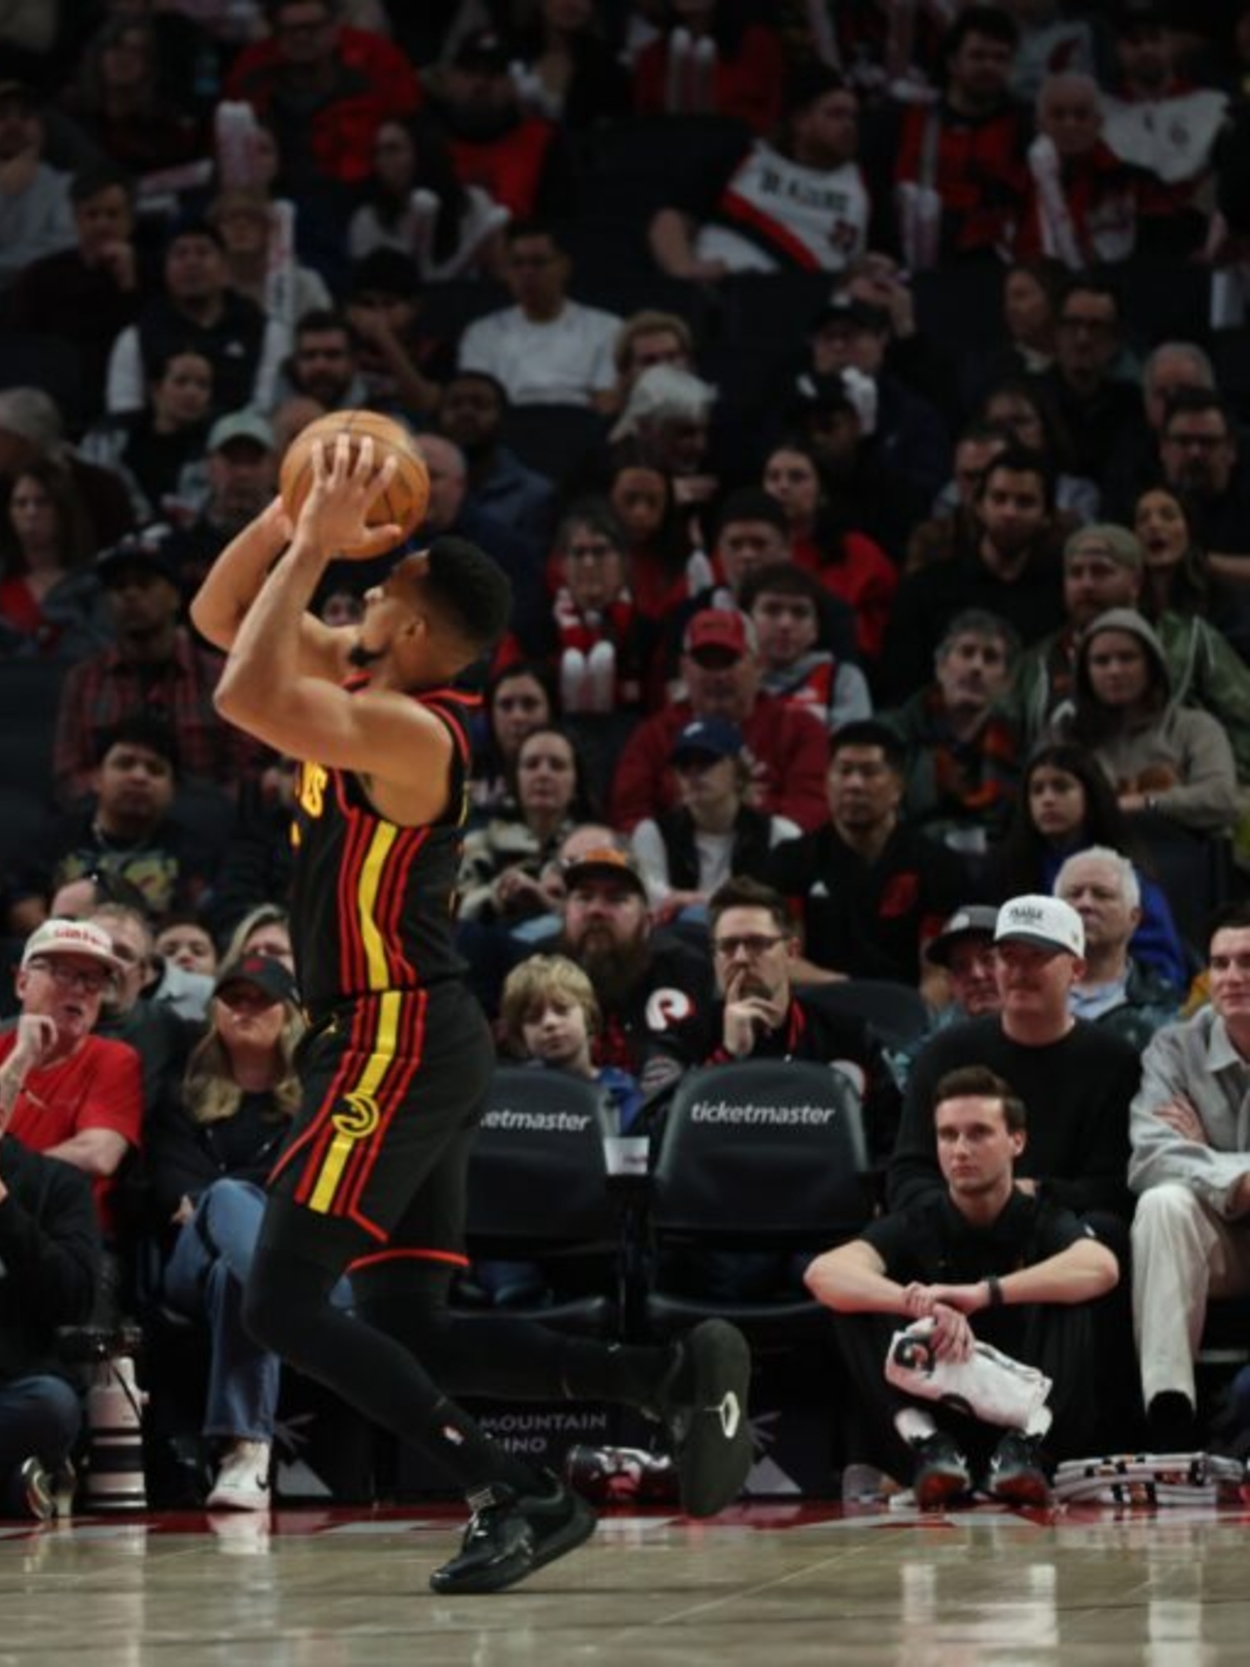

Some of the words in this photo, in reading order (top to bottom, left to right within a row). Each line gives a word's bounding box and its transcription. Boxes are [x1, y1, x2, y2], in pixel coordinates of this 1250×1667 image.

[481, 1109, 590, 1131] etmaster
[691, 1101, 835, 1124] ticketmaster
[480, 1413, 607, 1431] MOUNTAIN
[496, 1436, 548, 1453] INO
